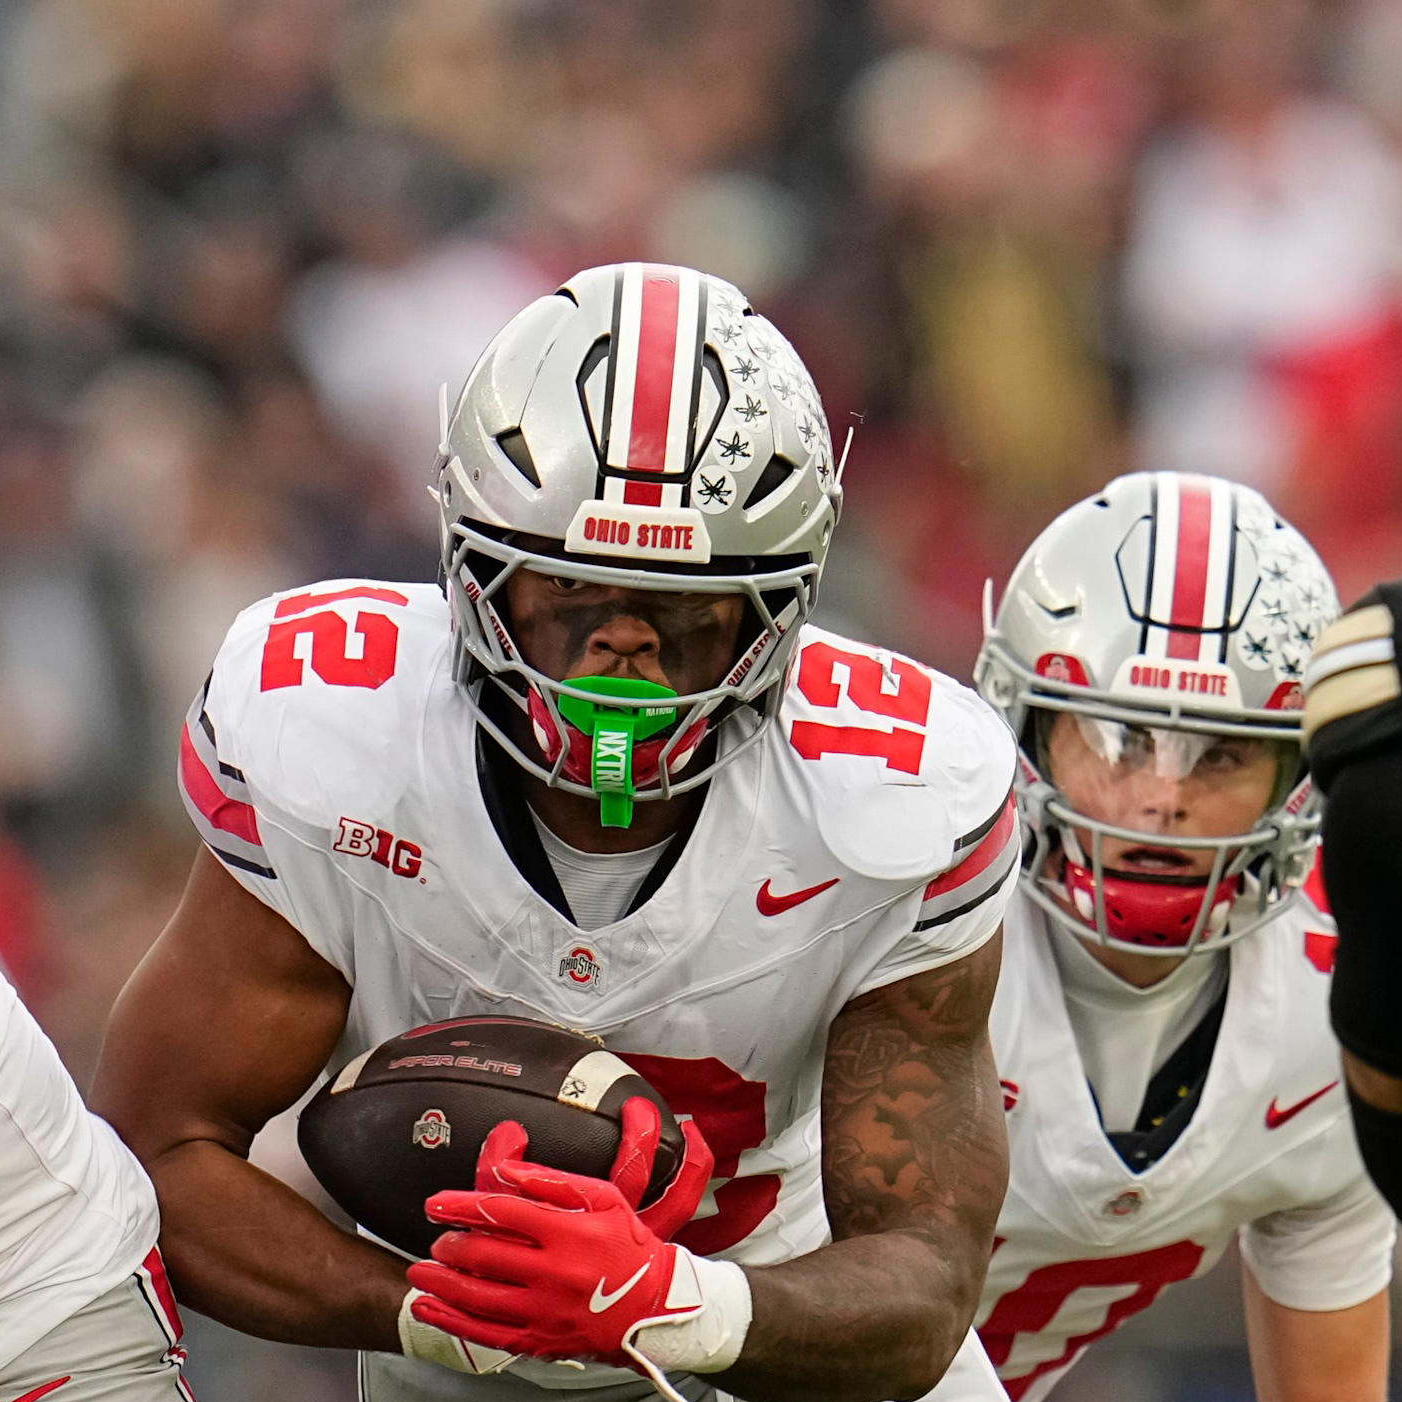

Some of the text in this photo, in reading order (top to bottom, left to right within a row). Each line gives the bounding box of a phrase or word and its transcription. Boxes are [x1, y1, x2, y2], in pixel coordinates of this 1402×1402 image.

[583, 516, 694, 551] OHIO STATE
[260, 586, 410, 692] 12
[727, 657, 754, 688] OHIO
[1130, 664, 1228, 697] OHIO STATE
[789, 641, 933, 776] 12
[455, 1055, 523, 1078] ELITE
